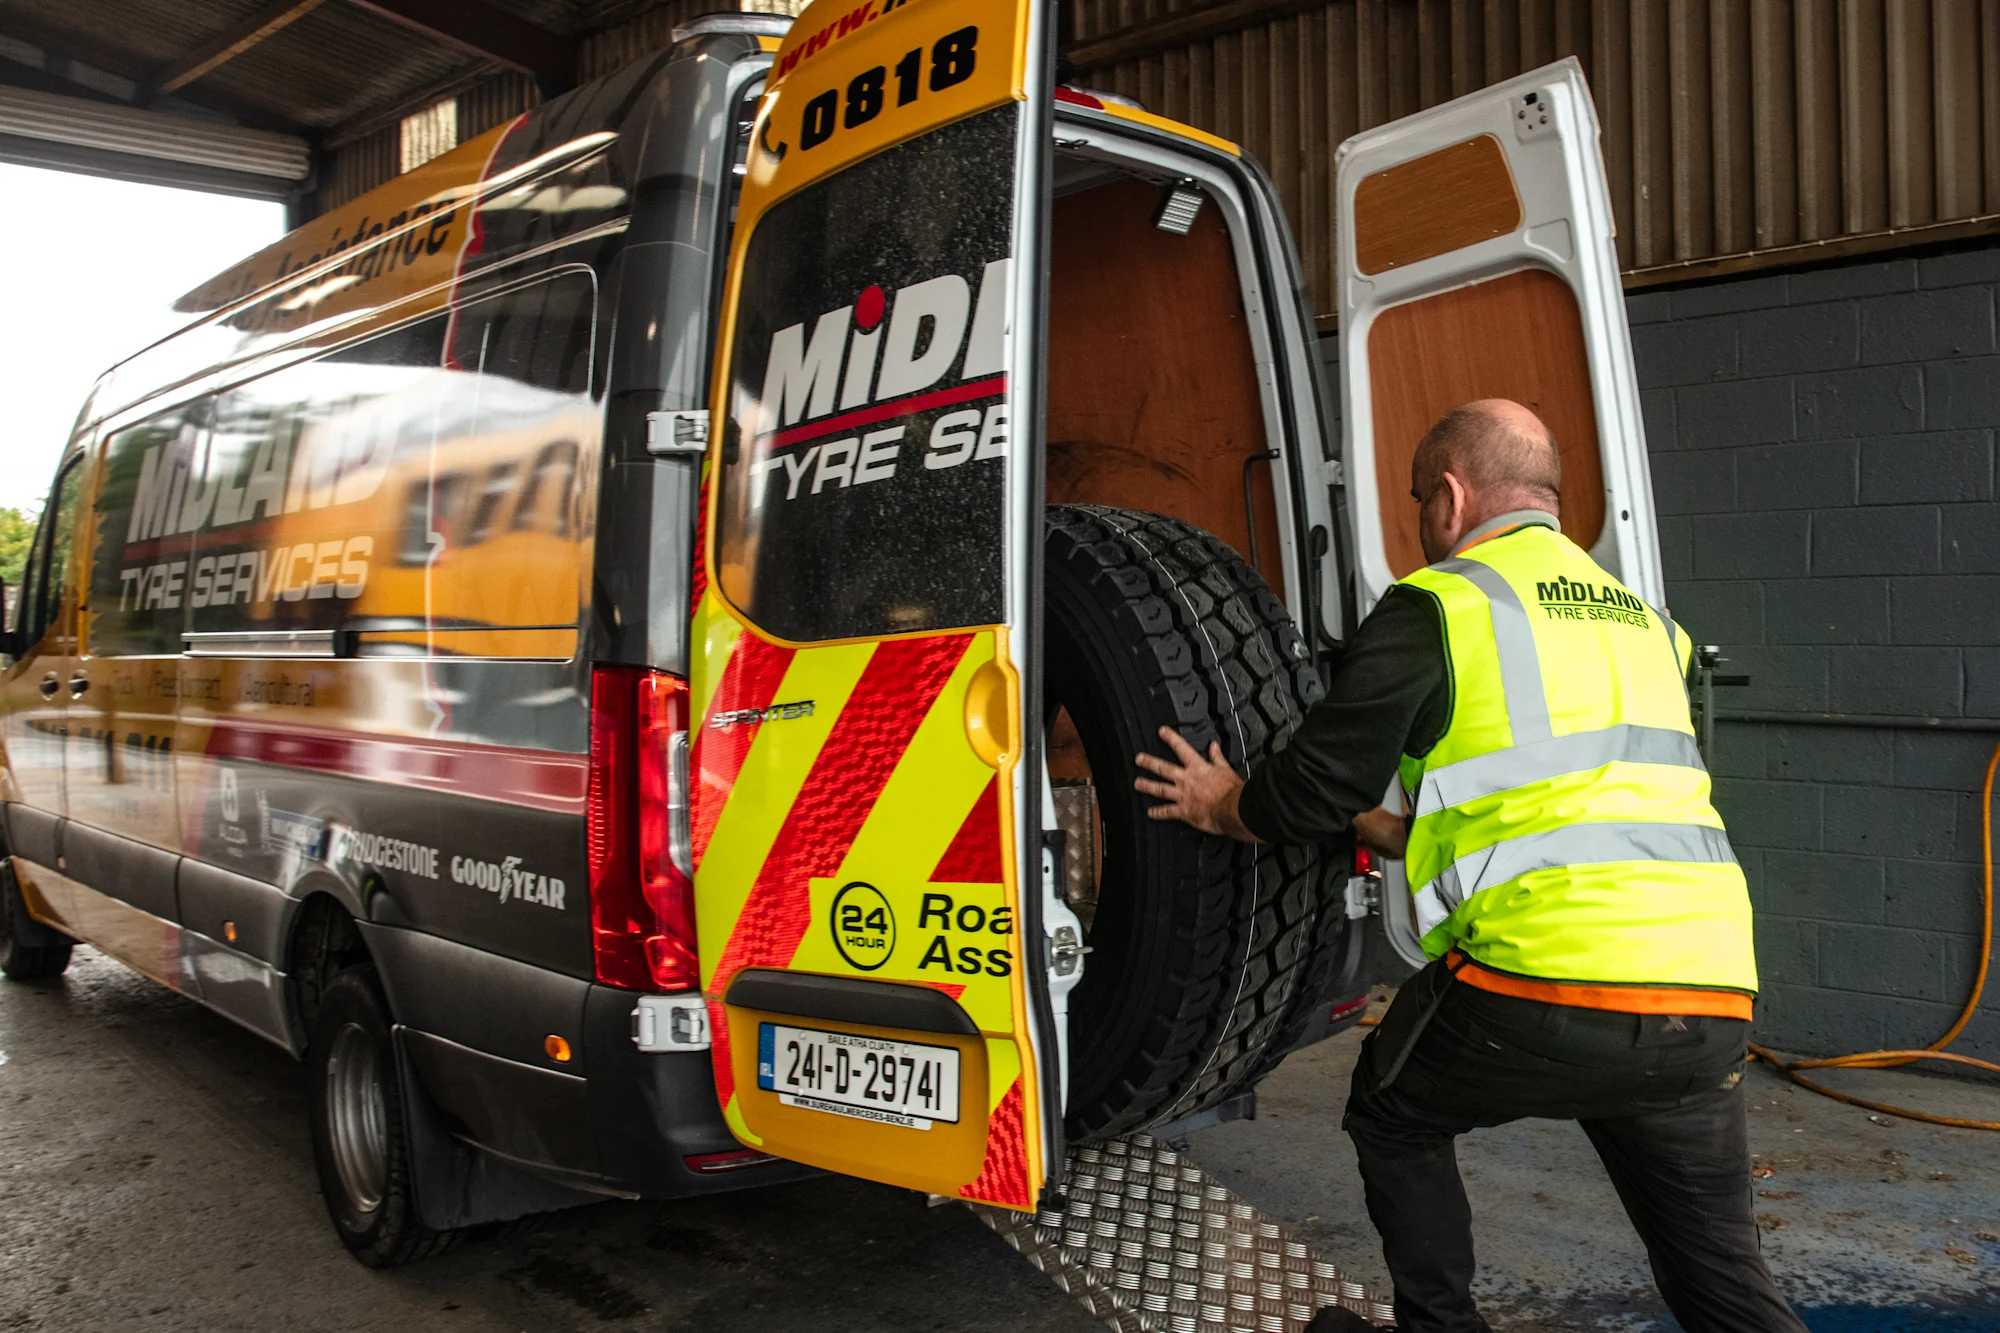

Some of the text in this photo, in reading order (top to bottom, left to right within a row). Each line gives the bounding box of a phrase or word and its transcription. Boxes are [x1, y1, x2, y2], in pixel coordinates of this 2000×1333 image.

[800, 25, 978, 151] 0818
[748, 403, 1010, 509] TYRE SE
[119, 536, 373, 612] TYRE SERVICES
[1544, 607, 1649, 630] TYRE SERVICES
[710, 699, 816, 729] SPRINTER
[451, 855, 566, 911] GOODYEAR
[841, 904, 888, 935] 24
[918, 893, 1014, 935] Roa
[846, 935, 886, 949] HOUR
[917, 935, 1014, 978] Ass
[828, 1034, 847, 1046] BAILE
[869, 1040, 895, 1052] CLIATH
[760, 1062, 774, 1078] IRL
[786, 1040, 941, 1111] 241-D-29741
